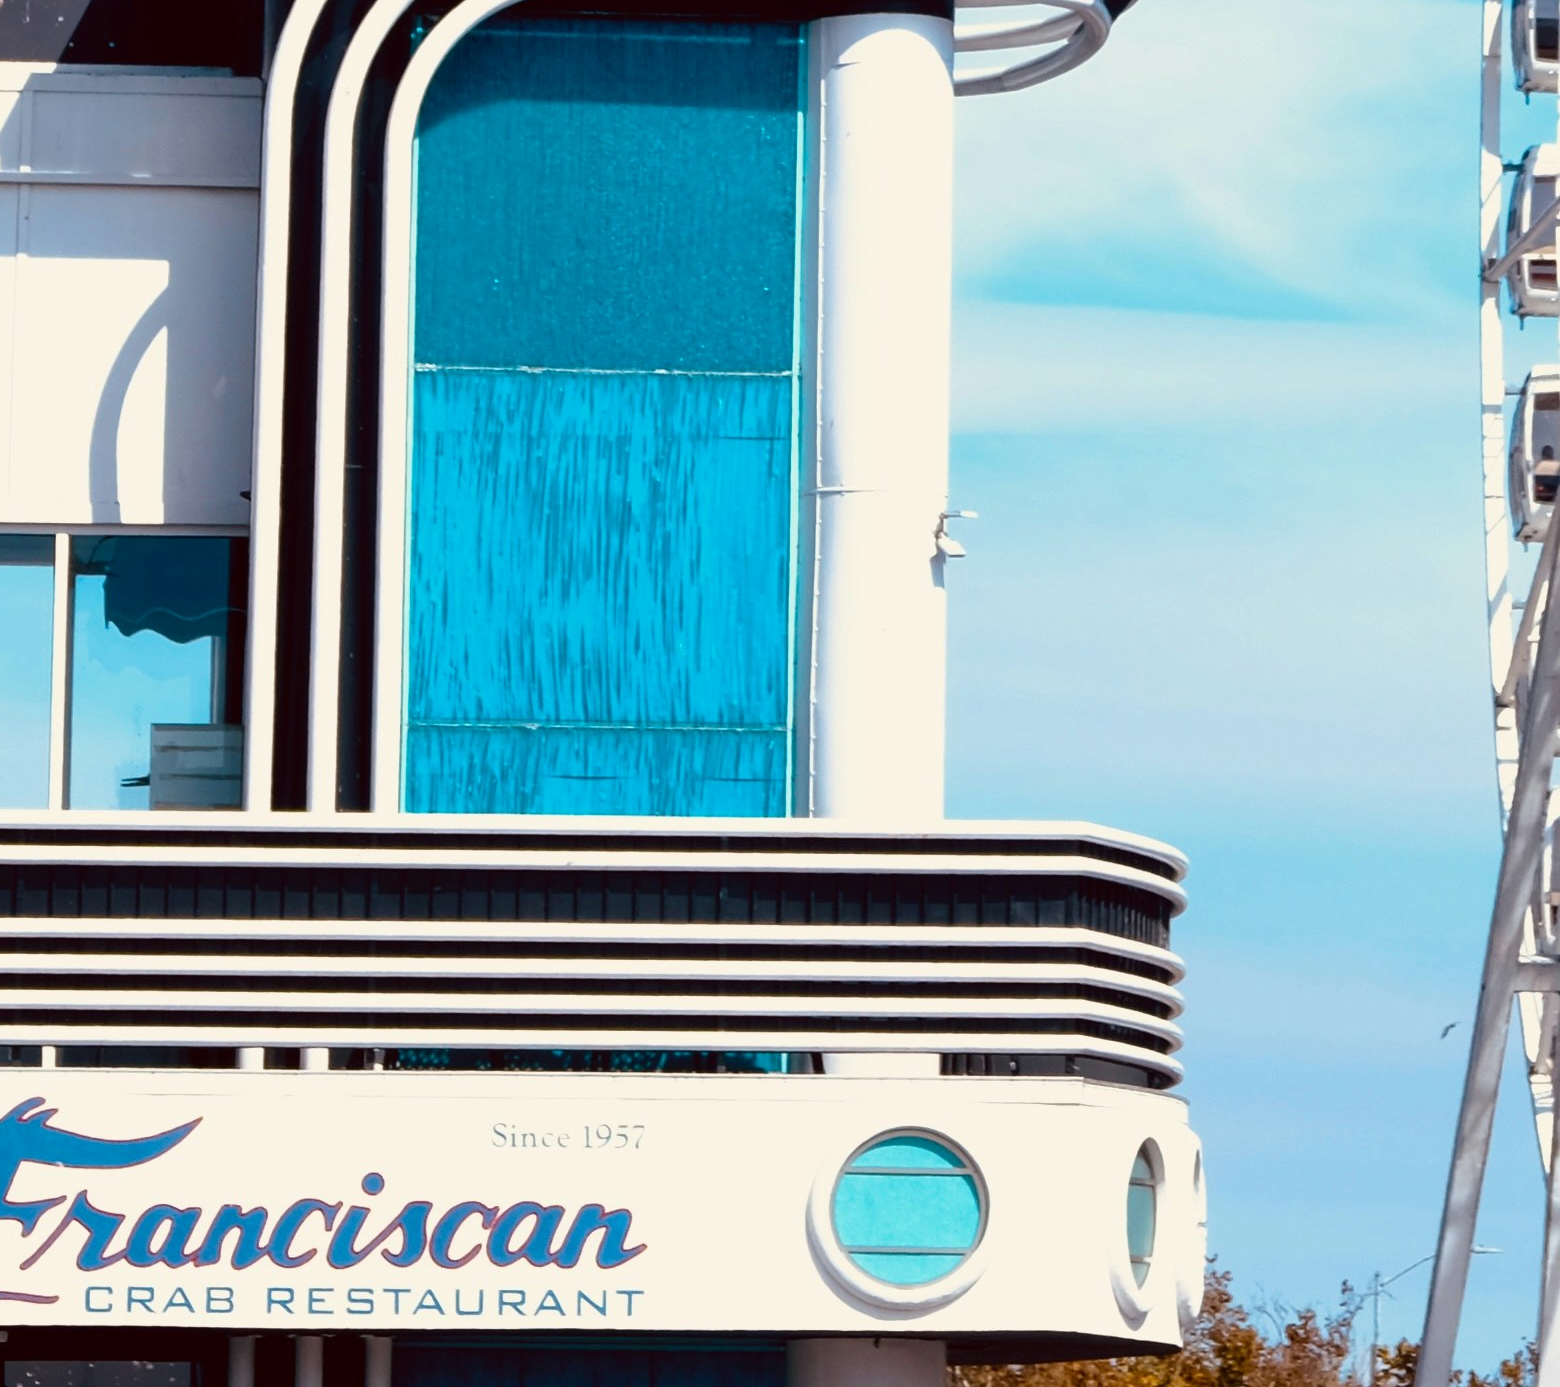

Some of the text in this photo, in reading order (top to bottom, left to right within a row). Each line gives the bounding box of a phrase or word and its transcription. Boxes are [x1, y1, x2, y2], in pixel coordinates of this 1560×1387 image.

[491, 1121, 646, 1149] Since 1957
[84, 1285, 646, 1317] CRAB RESTAURANT
